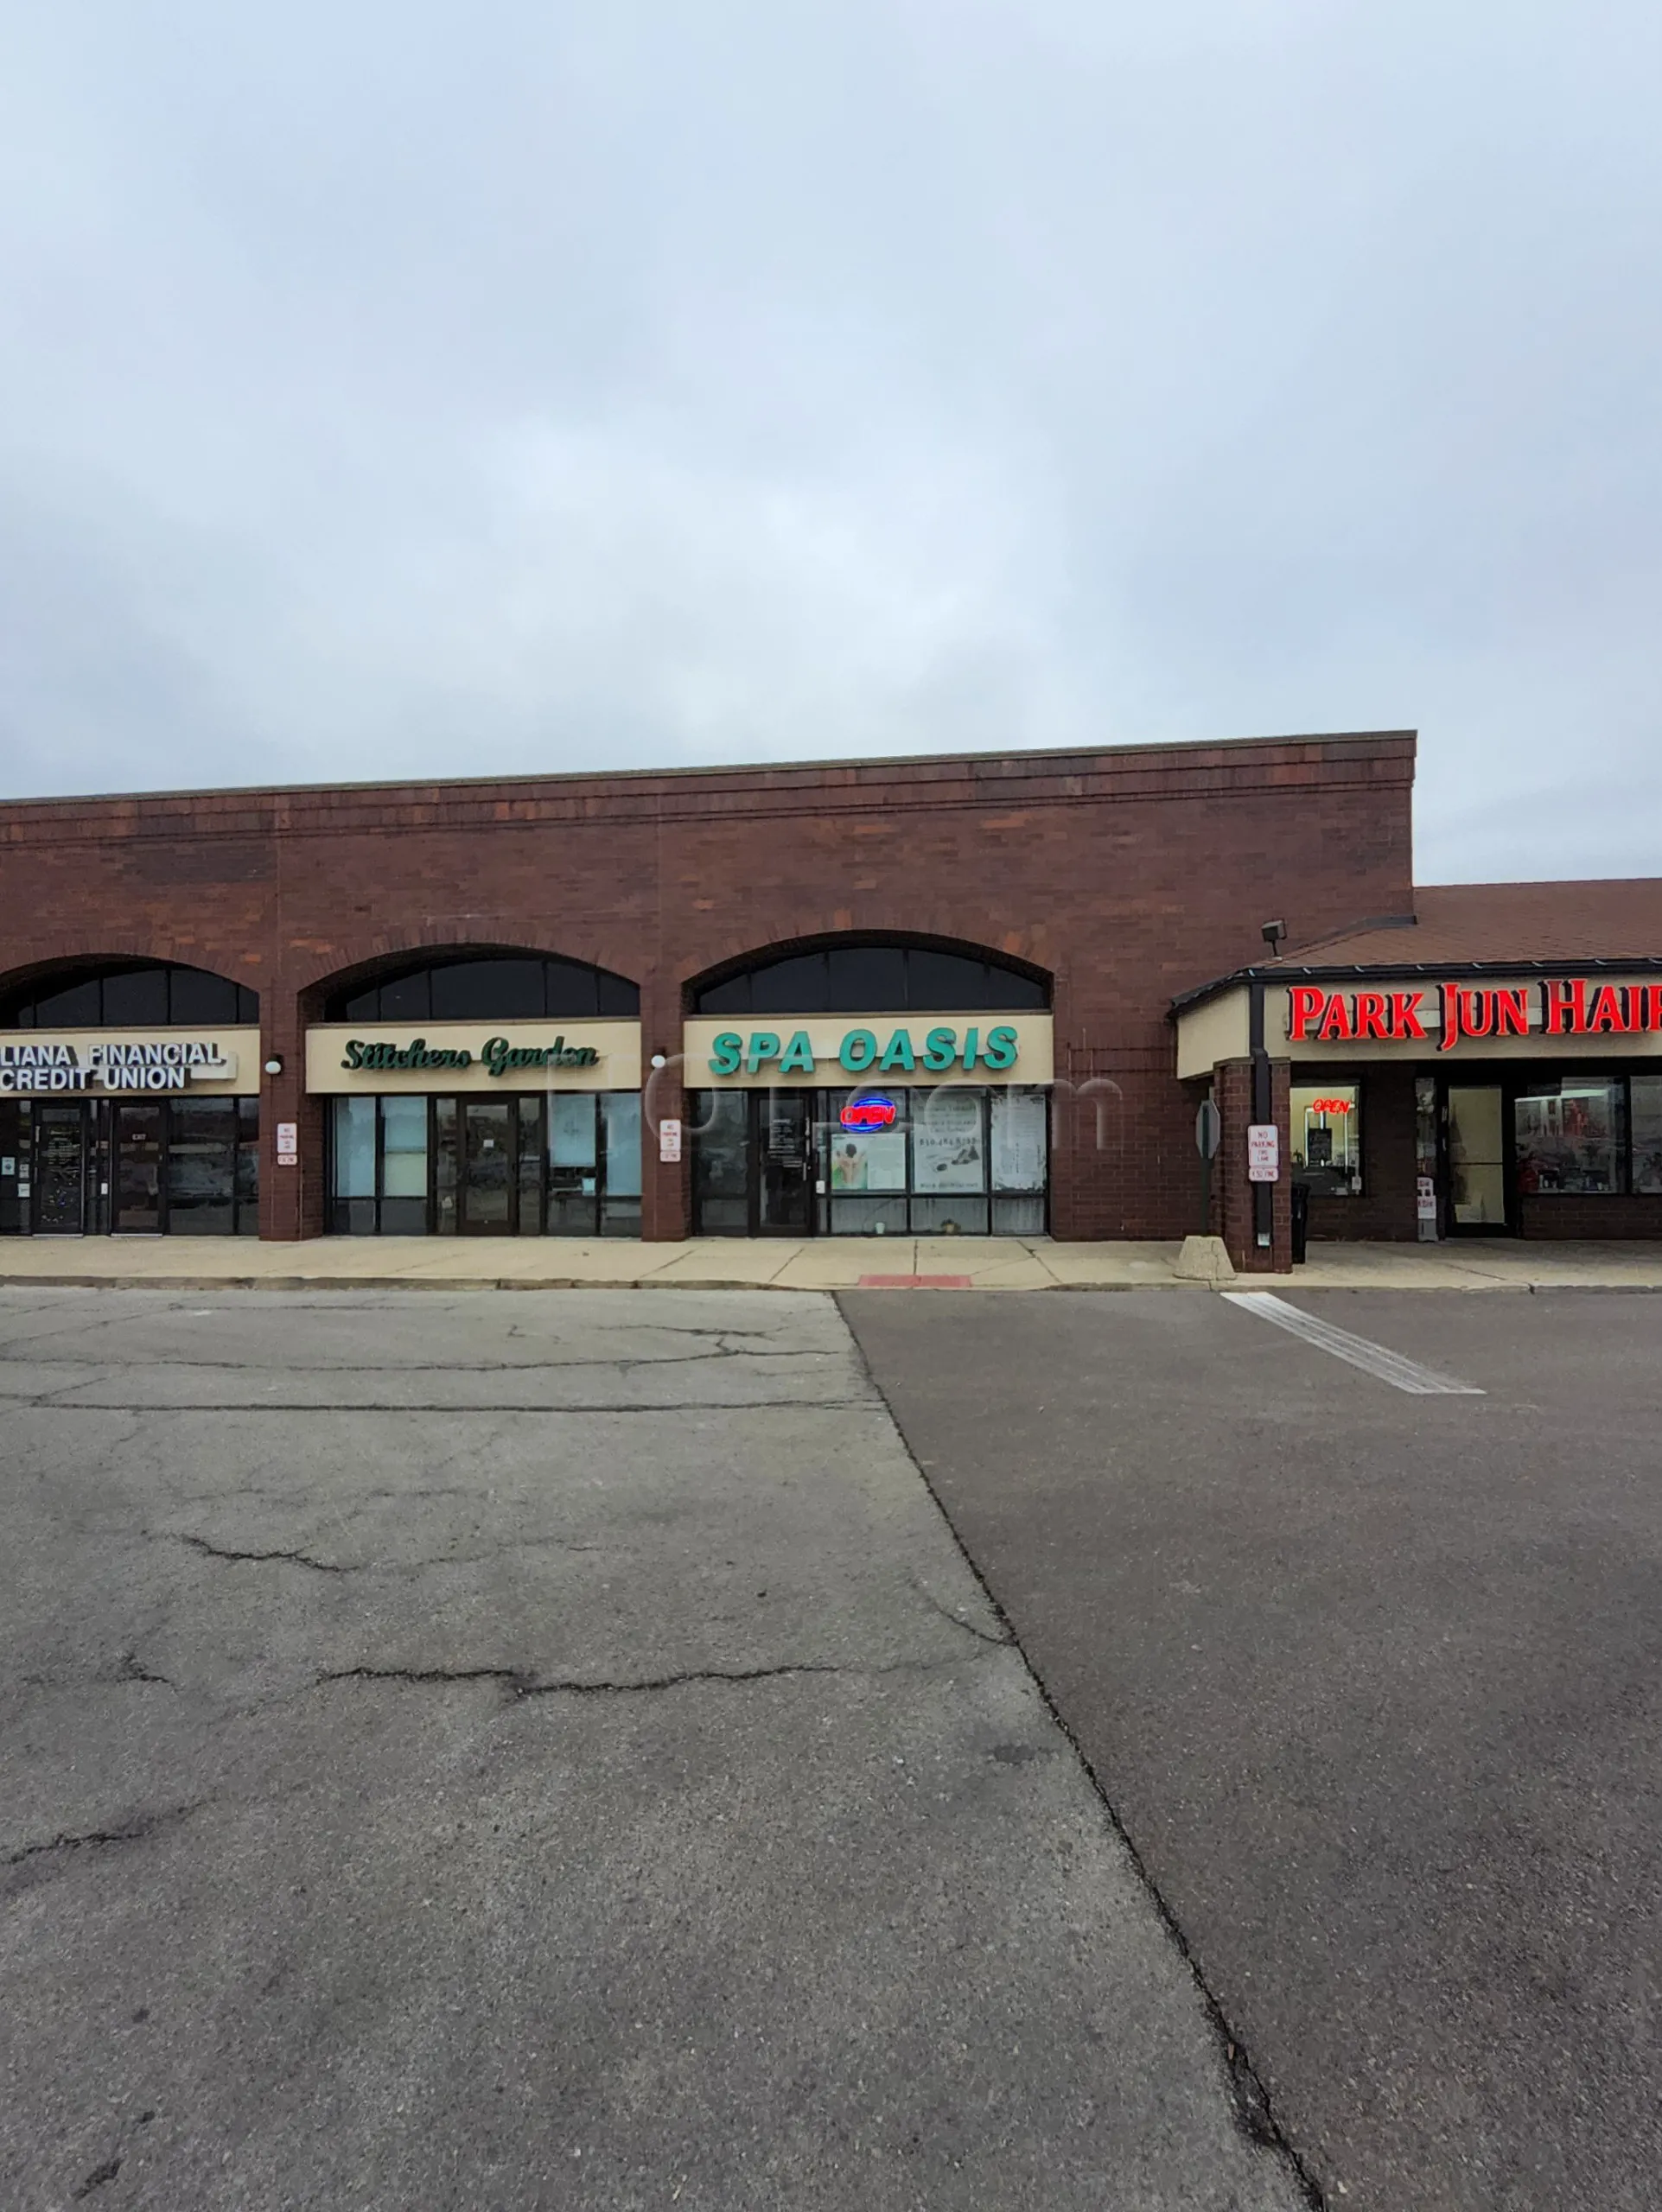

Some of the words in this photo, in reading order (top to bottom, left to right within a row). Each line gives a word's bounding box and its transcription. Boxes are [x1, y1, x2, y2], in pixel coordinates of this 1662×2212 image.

[0, 1045, 79, 1066] LIANA
[88, 1042, 227, 1065] FINANCIAL
[341, 1039, 471, 1070] Stitchers
[481, 1036, 599, 1077] Garden
[709, 1031, 815, 1076] SPA
[839, 1026, 1018, 1071] OASIS
[0, 1068, 92, 1090] CREDIT
[103, 1066, 191, 1090] UNION
[840, 1105, 896, 1124] OPEN
[1313, 1097, 1351, 1115] OPEN
[1258, 1130, 1269, 1139] NO
